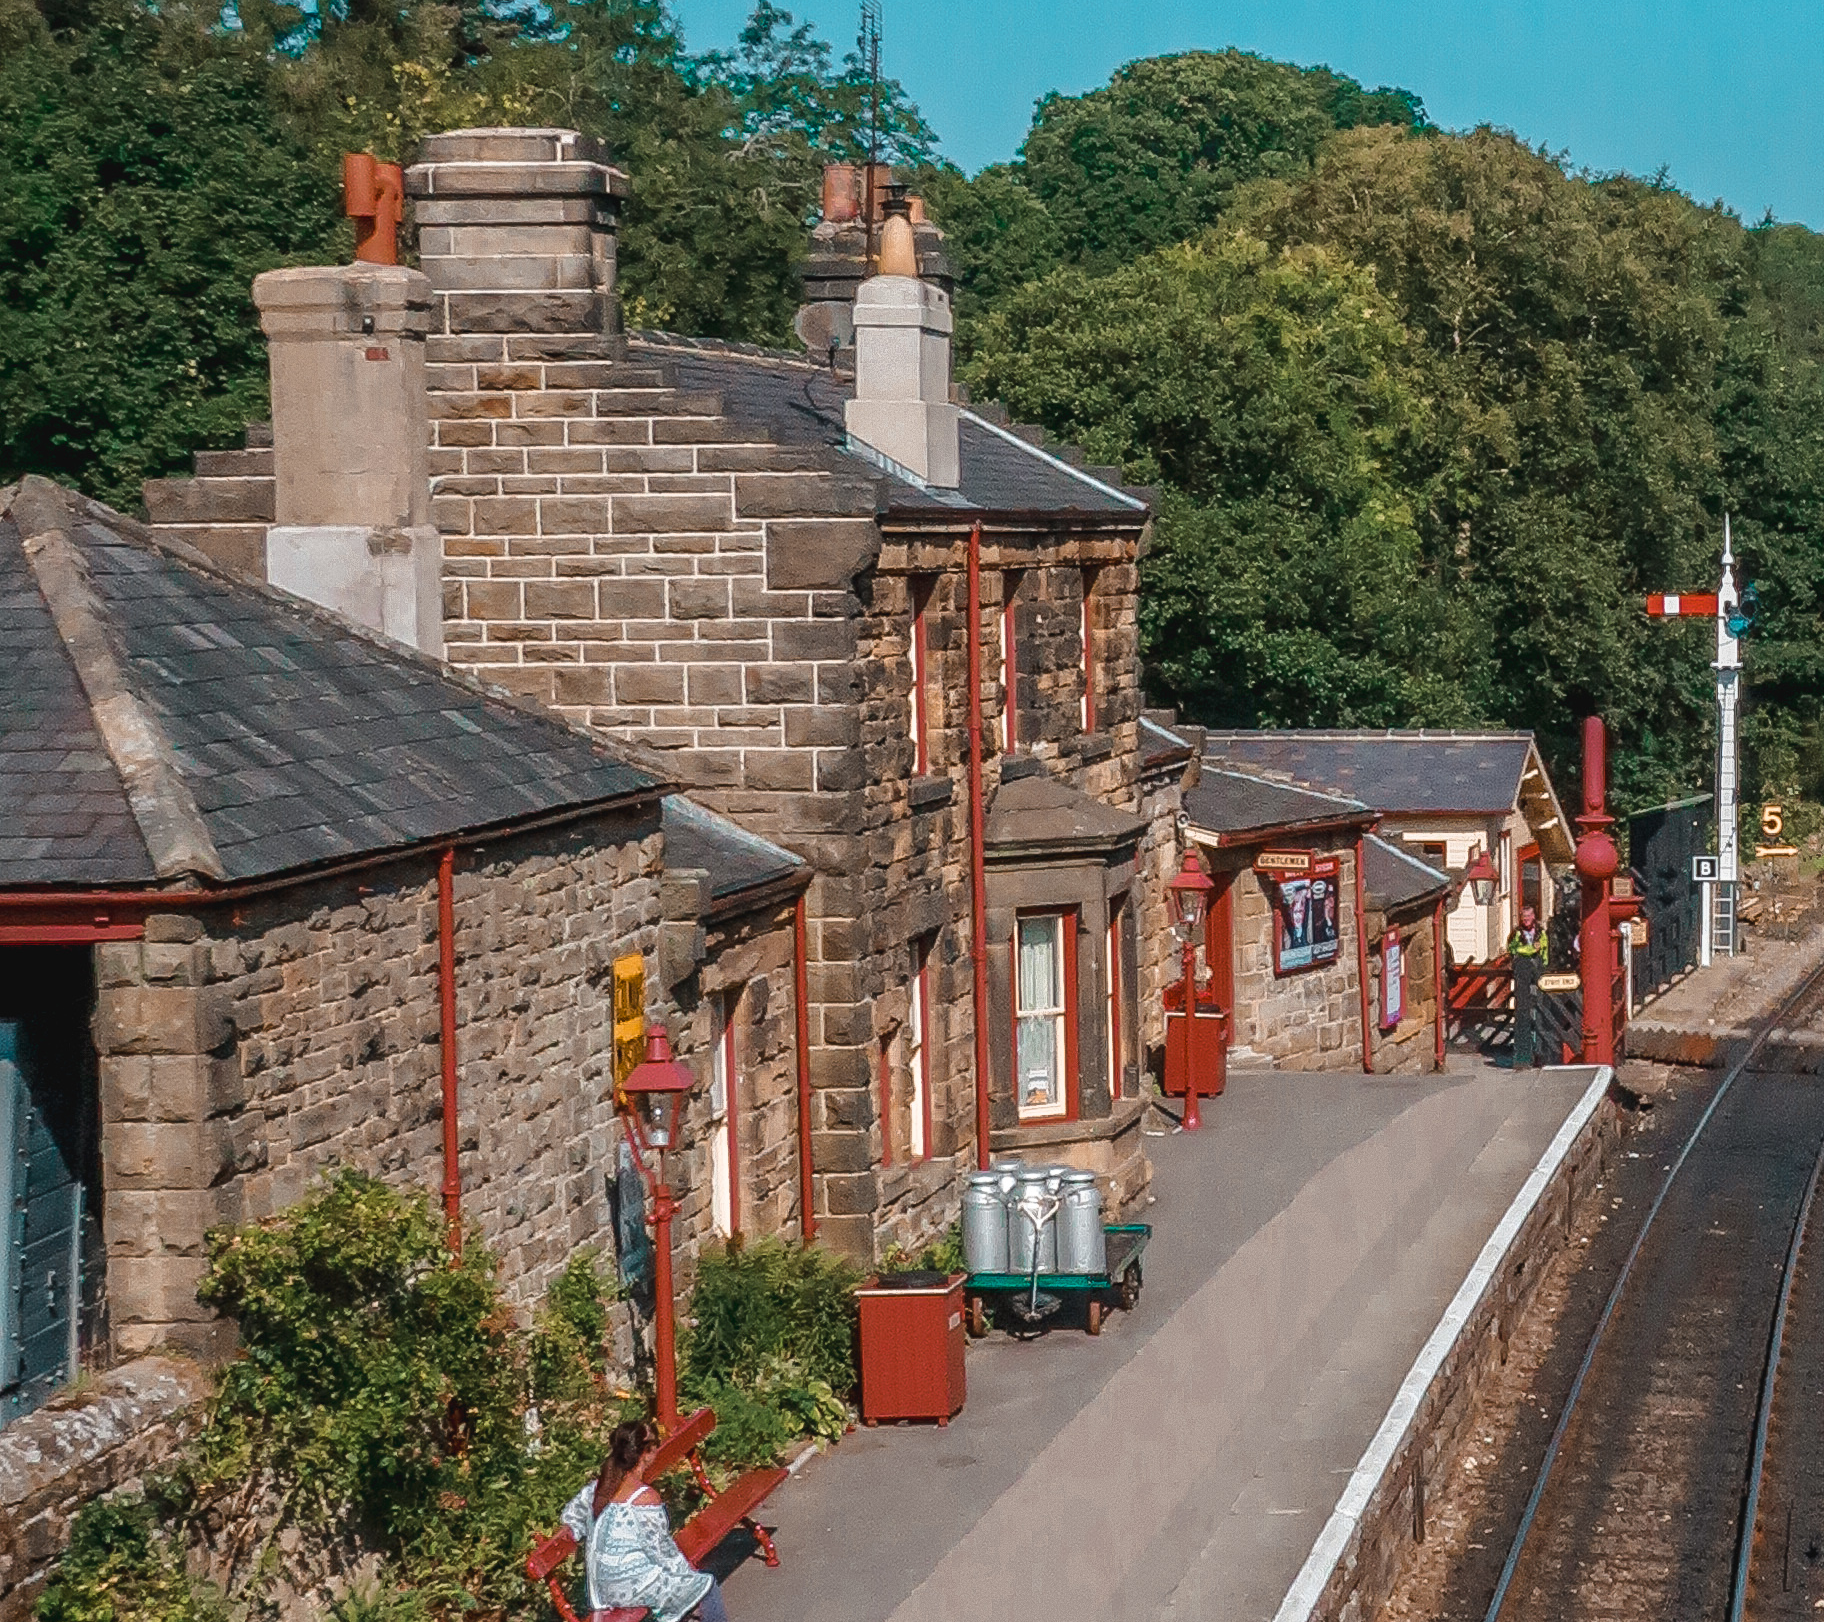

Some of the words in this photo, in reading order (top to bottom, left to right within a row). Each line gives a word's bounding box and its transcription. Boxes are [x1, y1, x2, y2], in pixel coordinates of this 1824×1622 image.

[1762, 805, 1782, 835] 5
[1260, 856, 1306, 865] GENTLEMEN
[1701, 861, 1712, 875] B
